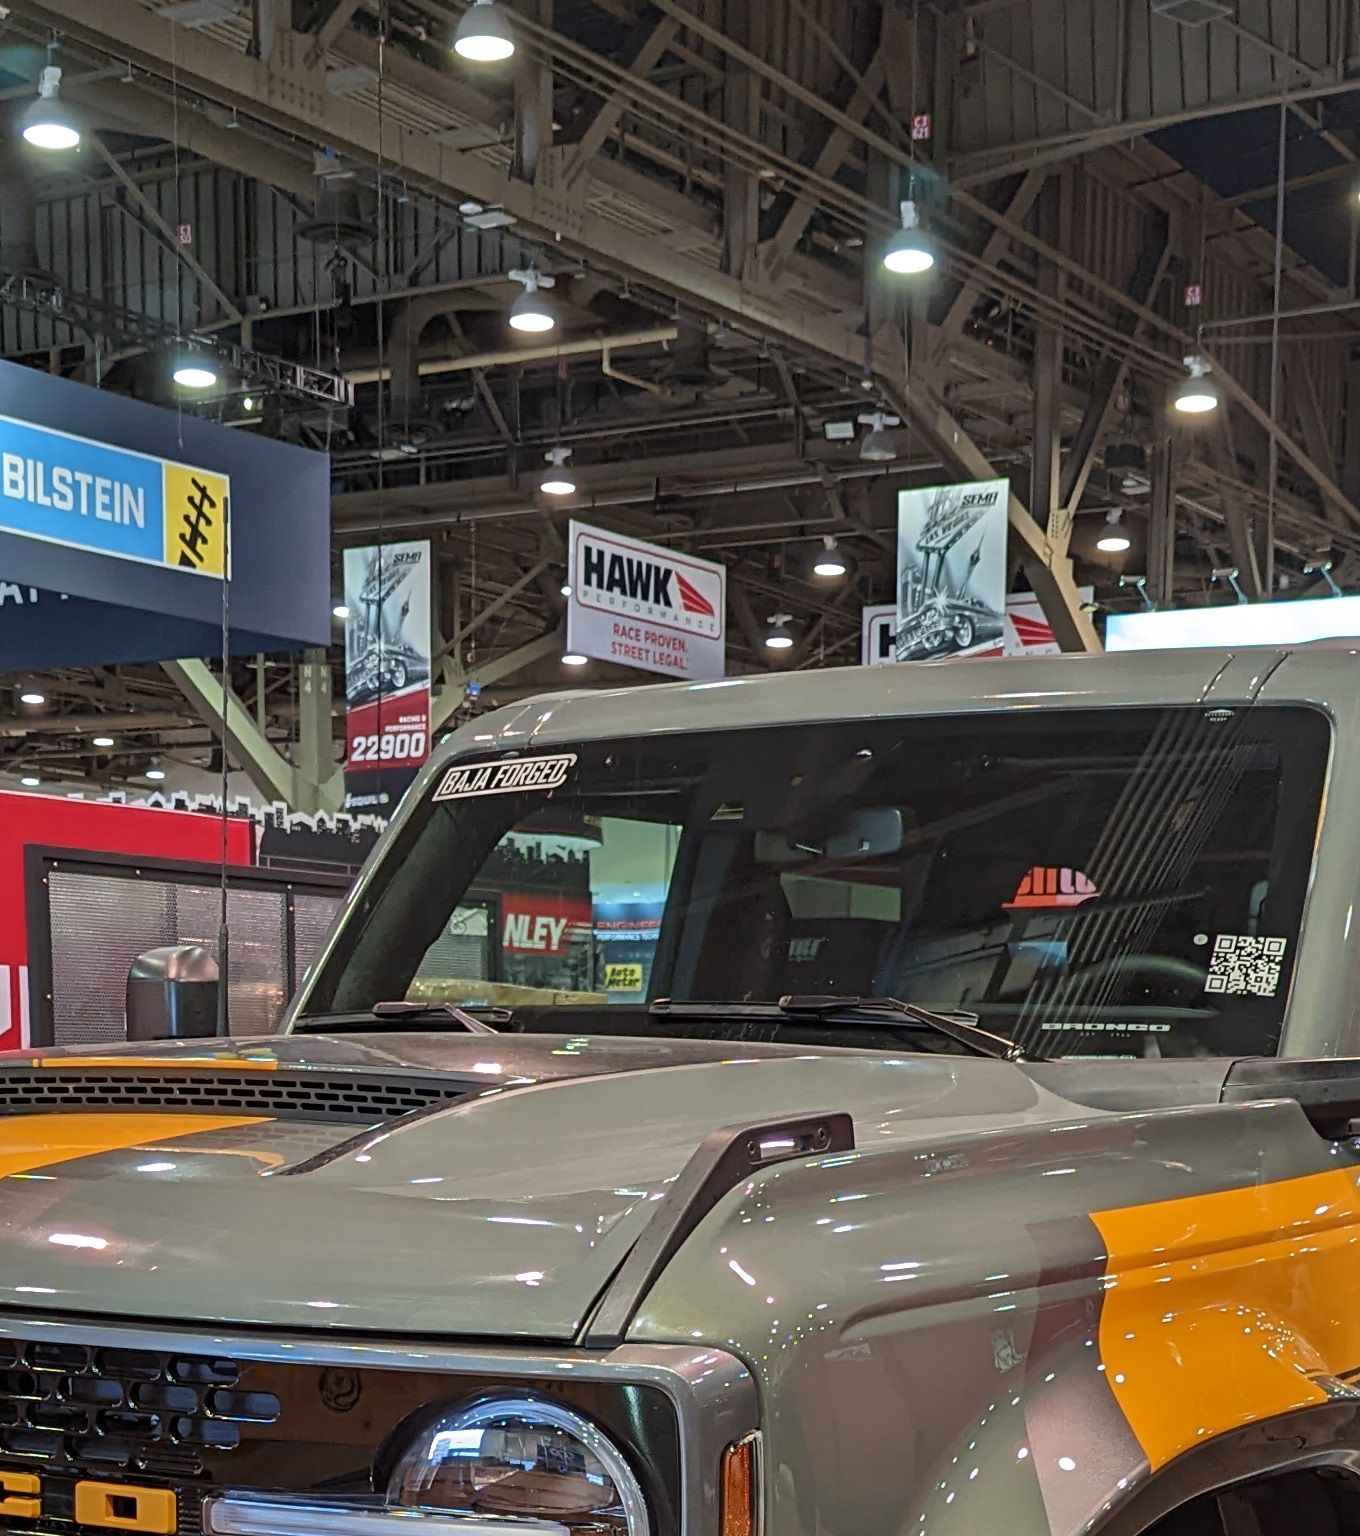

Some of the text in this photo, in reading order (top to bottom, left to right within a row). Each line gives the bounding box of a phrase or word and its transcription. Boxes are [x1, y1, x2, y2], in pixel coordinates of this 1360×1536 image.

[2, 451, 145, 531] BILSTEIN
[583, 545, 673, 609] HAWK
[583, 590, 716, 632] PERFORMANCE
[611, 641, 651, 661] STREET
[612, 624, 641, 642] RACE
[351, 732, 426, 762] 22900
[440, 758, 569, 796] BAJA FORGED
